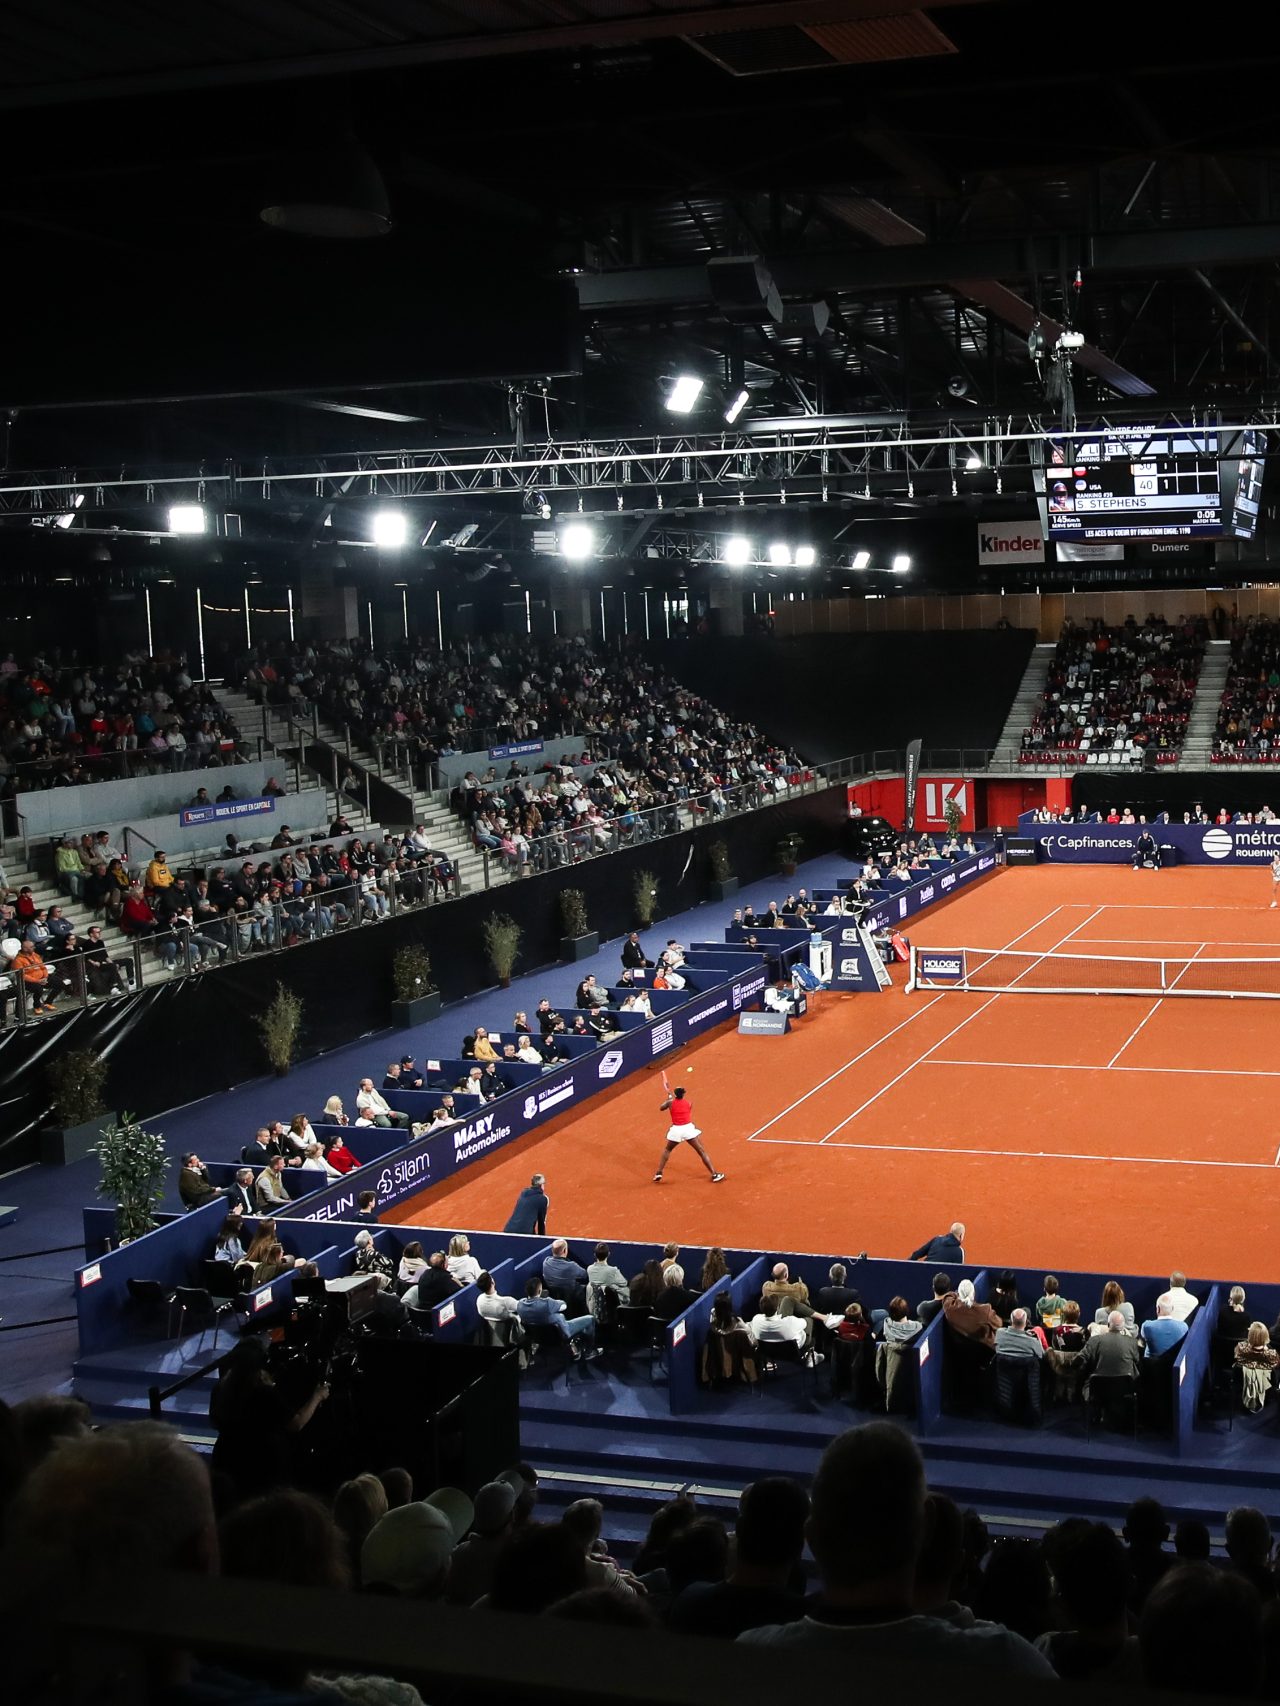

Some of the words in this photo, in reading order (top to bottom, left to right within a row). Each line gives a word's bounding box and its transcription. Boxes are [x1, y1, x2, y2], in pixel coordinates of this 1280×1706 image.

[1089, 443, 1133, 455] LIETTE
[1139, 480, 1153, 490] 40
[1163, 479, 1169, 490] 1
[1090, 498, 1147, 509] STEPHENS
[1197, 511, 1215, 519] 0:09
[1085, 530, 1094, 538] LES
[1137, 528, 1163, 536] FONDATION
[1151, 543, 1190, 553] Dumerc
[923, 959, 961, 968] HOLOGIC
[453, 1113, 495, 1149] MARY
[455, 1125, 511, 1163] Automobiles
